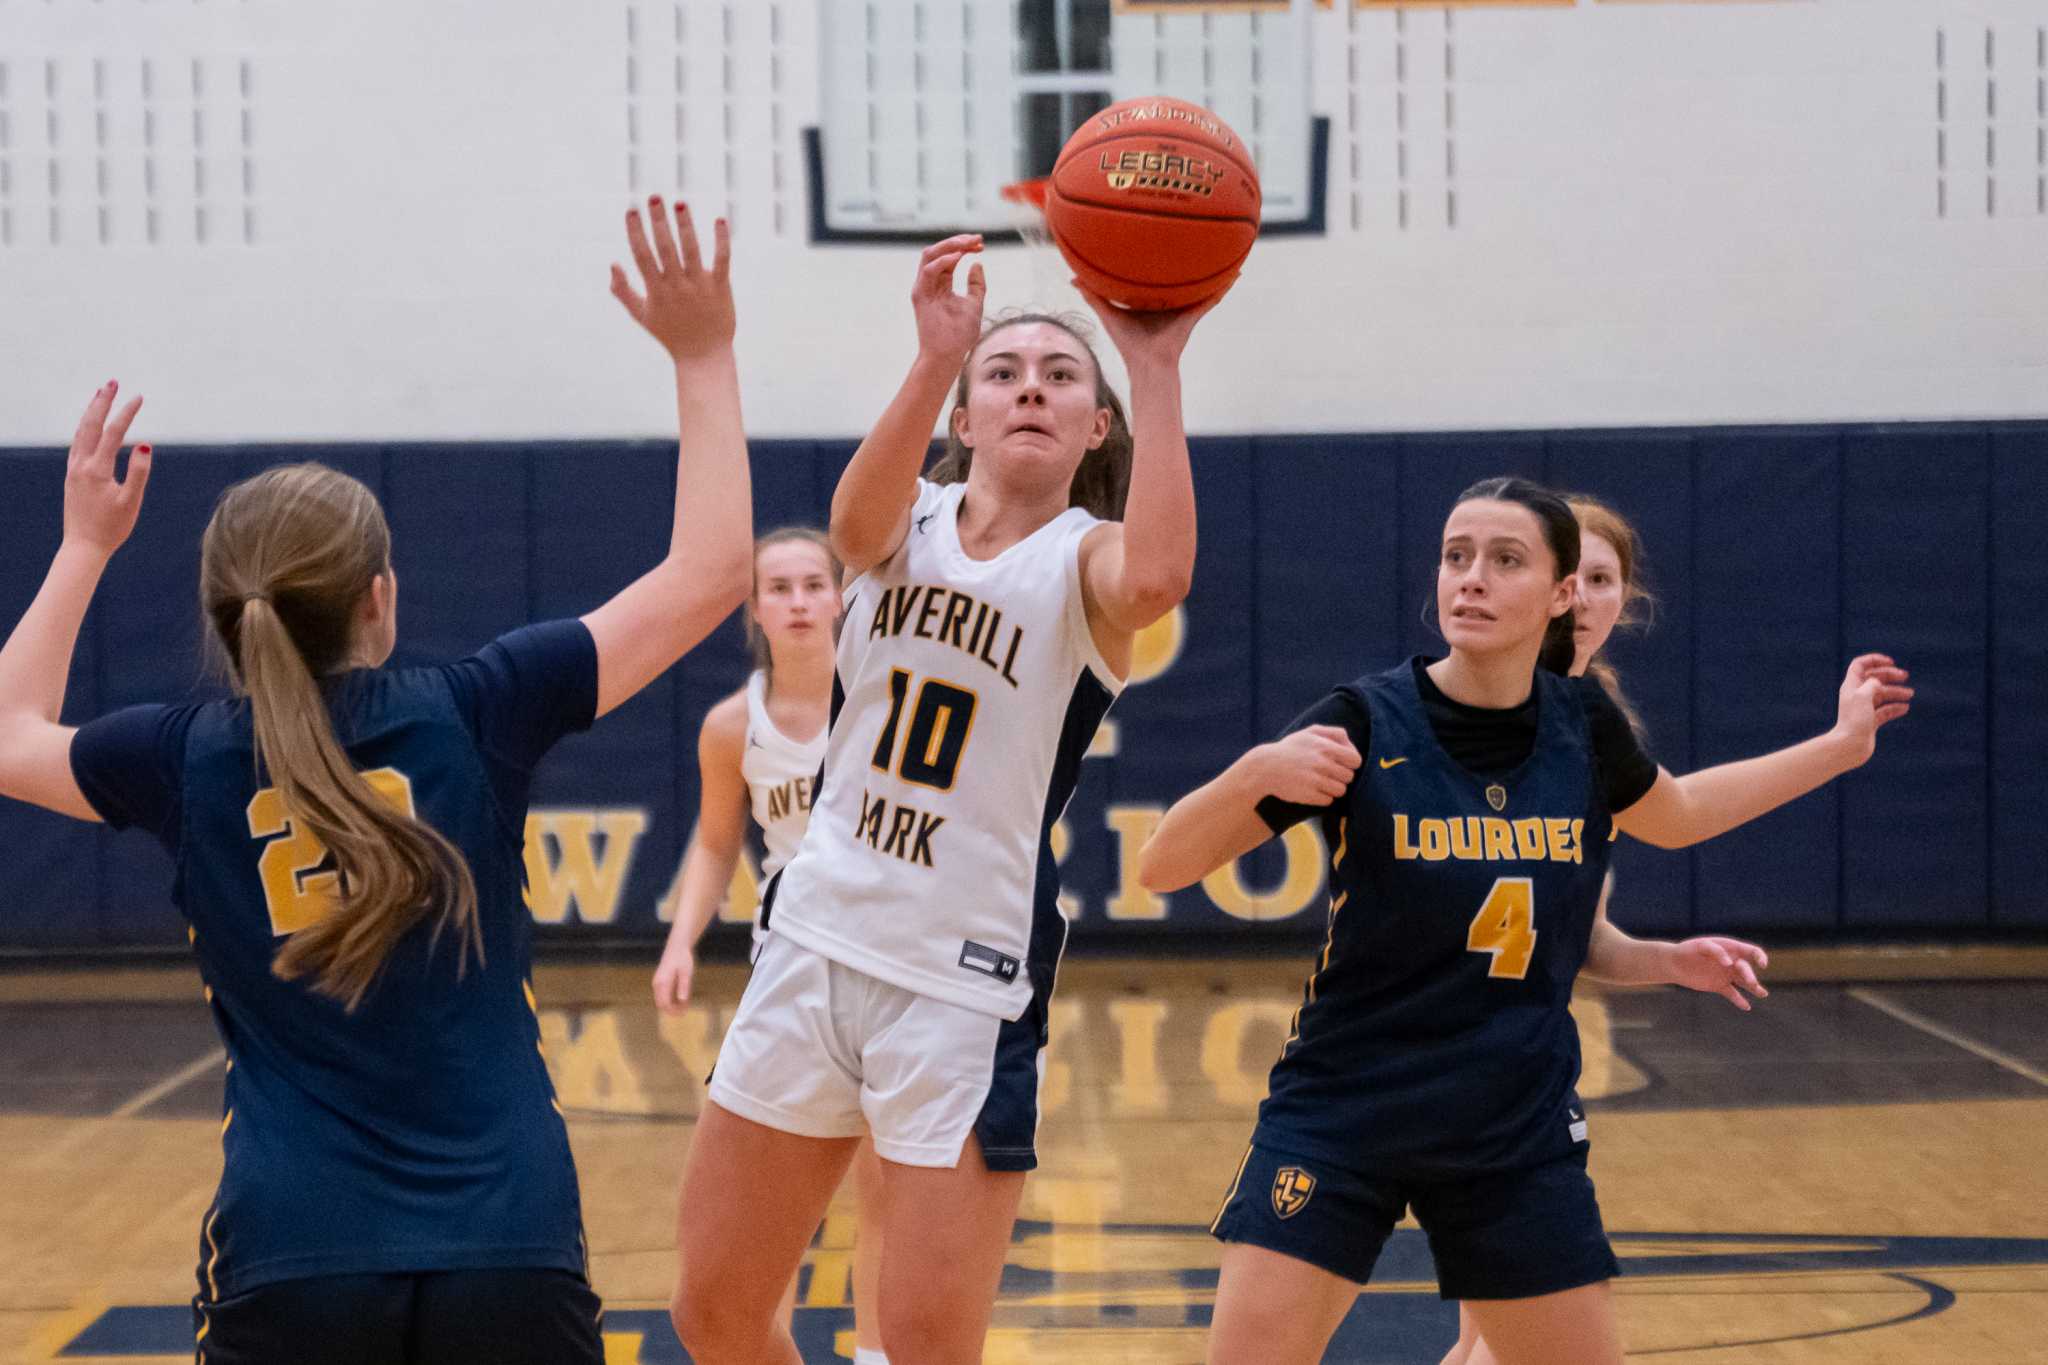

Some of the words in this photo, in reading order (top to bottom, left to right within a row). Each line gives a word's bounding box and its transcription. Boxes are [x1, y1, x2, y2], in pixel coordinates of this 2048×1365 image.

[1099, 151, 1224, 183] LEGACY
[869, 585, 1023, 689] AVERILL
[871, 666, 979, 794] 10
[246, 766, 417, 937] 2
[1001, 960, 1014, 976] M
[1466, 876, 1537, 980] 4
